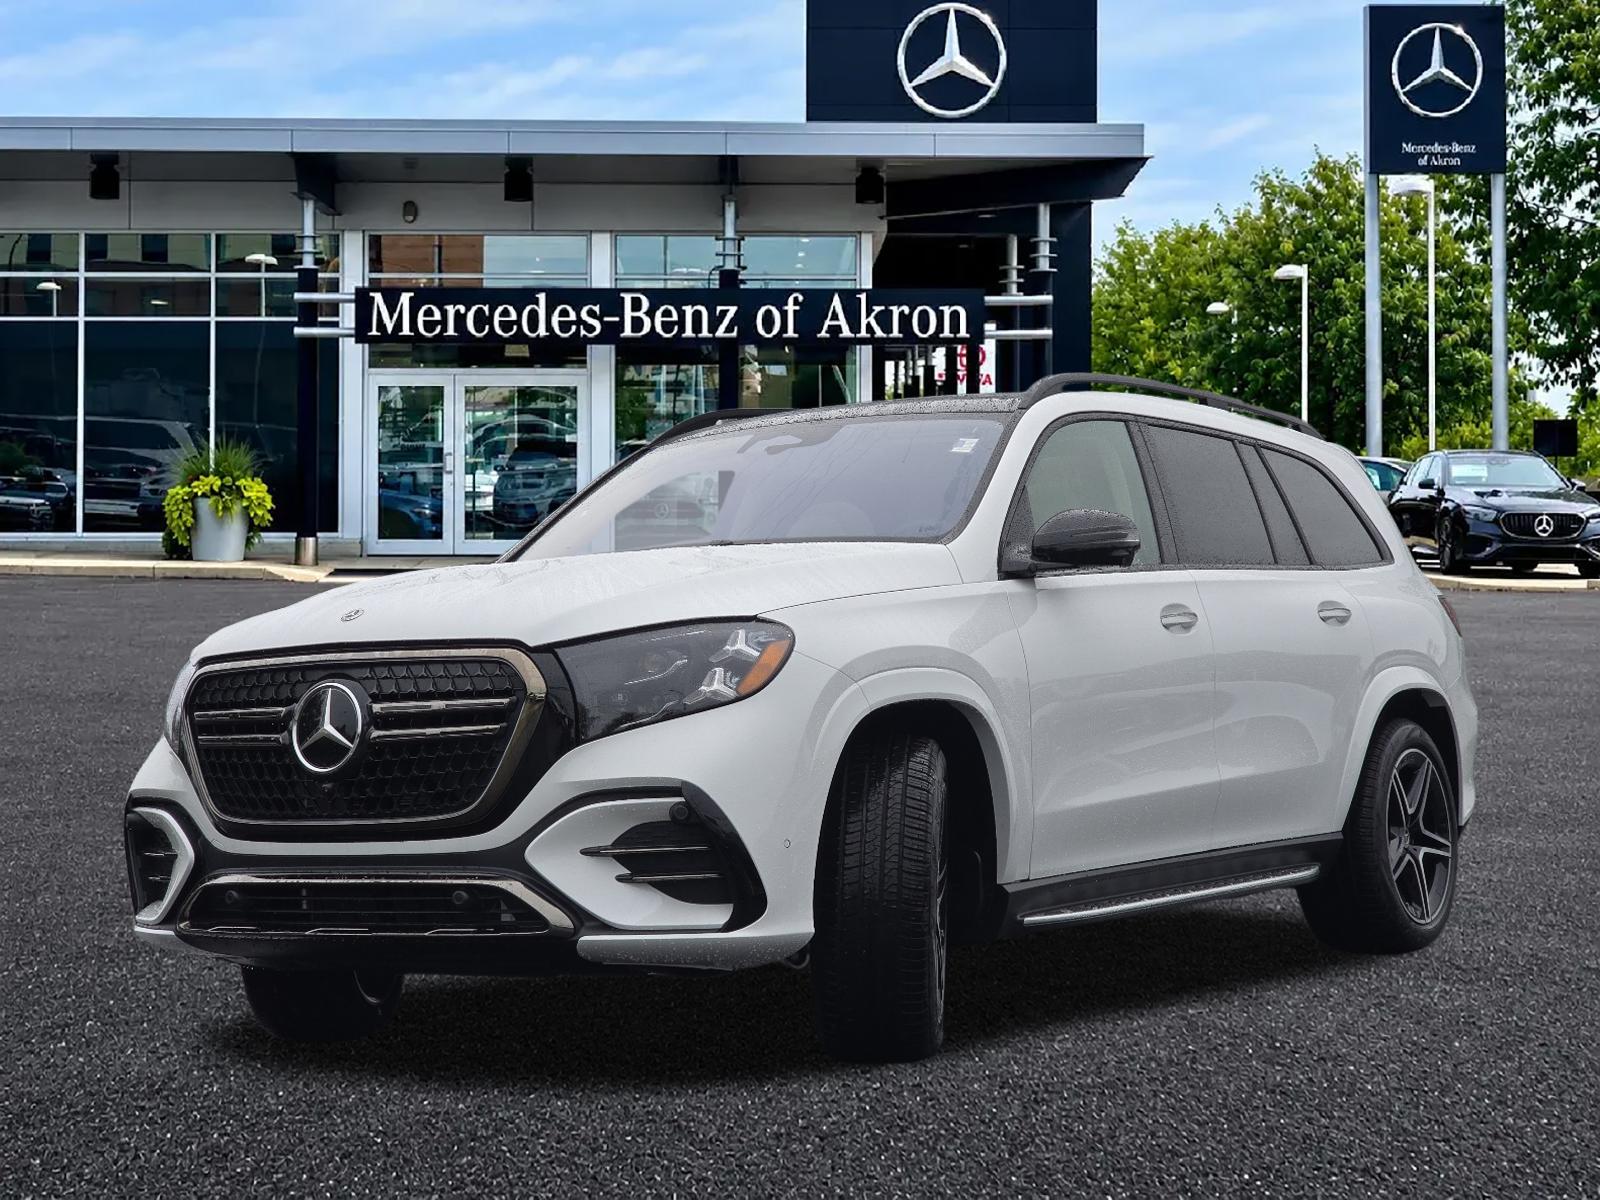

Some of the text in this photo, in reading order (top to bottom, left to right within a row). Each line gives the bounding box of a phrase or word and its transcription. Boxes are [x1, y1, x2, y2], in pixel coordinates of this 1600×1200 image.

[1418, 154, 1461, 166] of Akron
[367, 292, 970, 338] Mercedes-Benz of Akron
